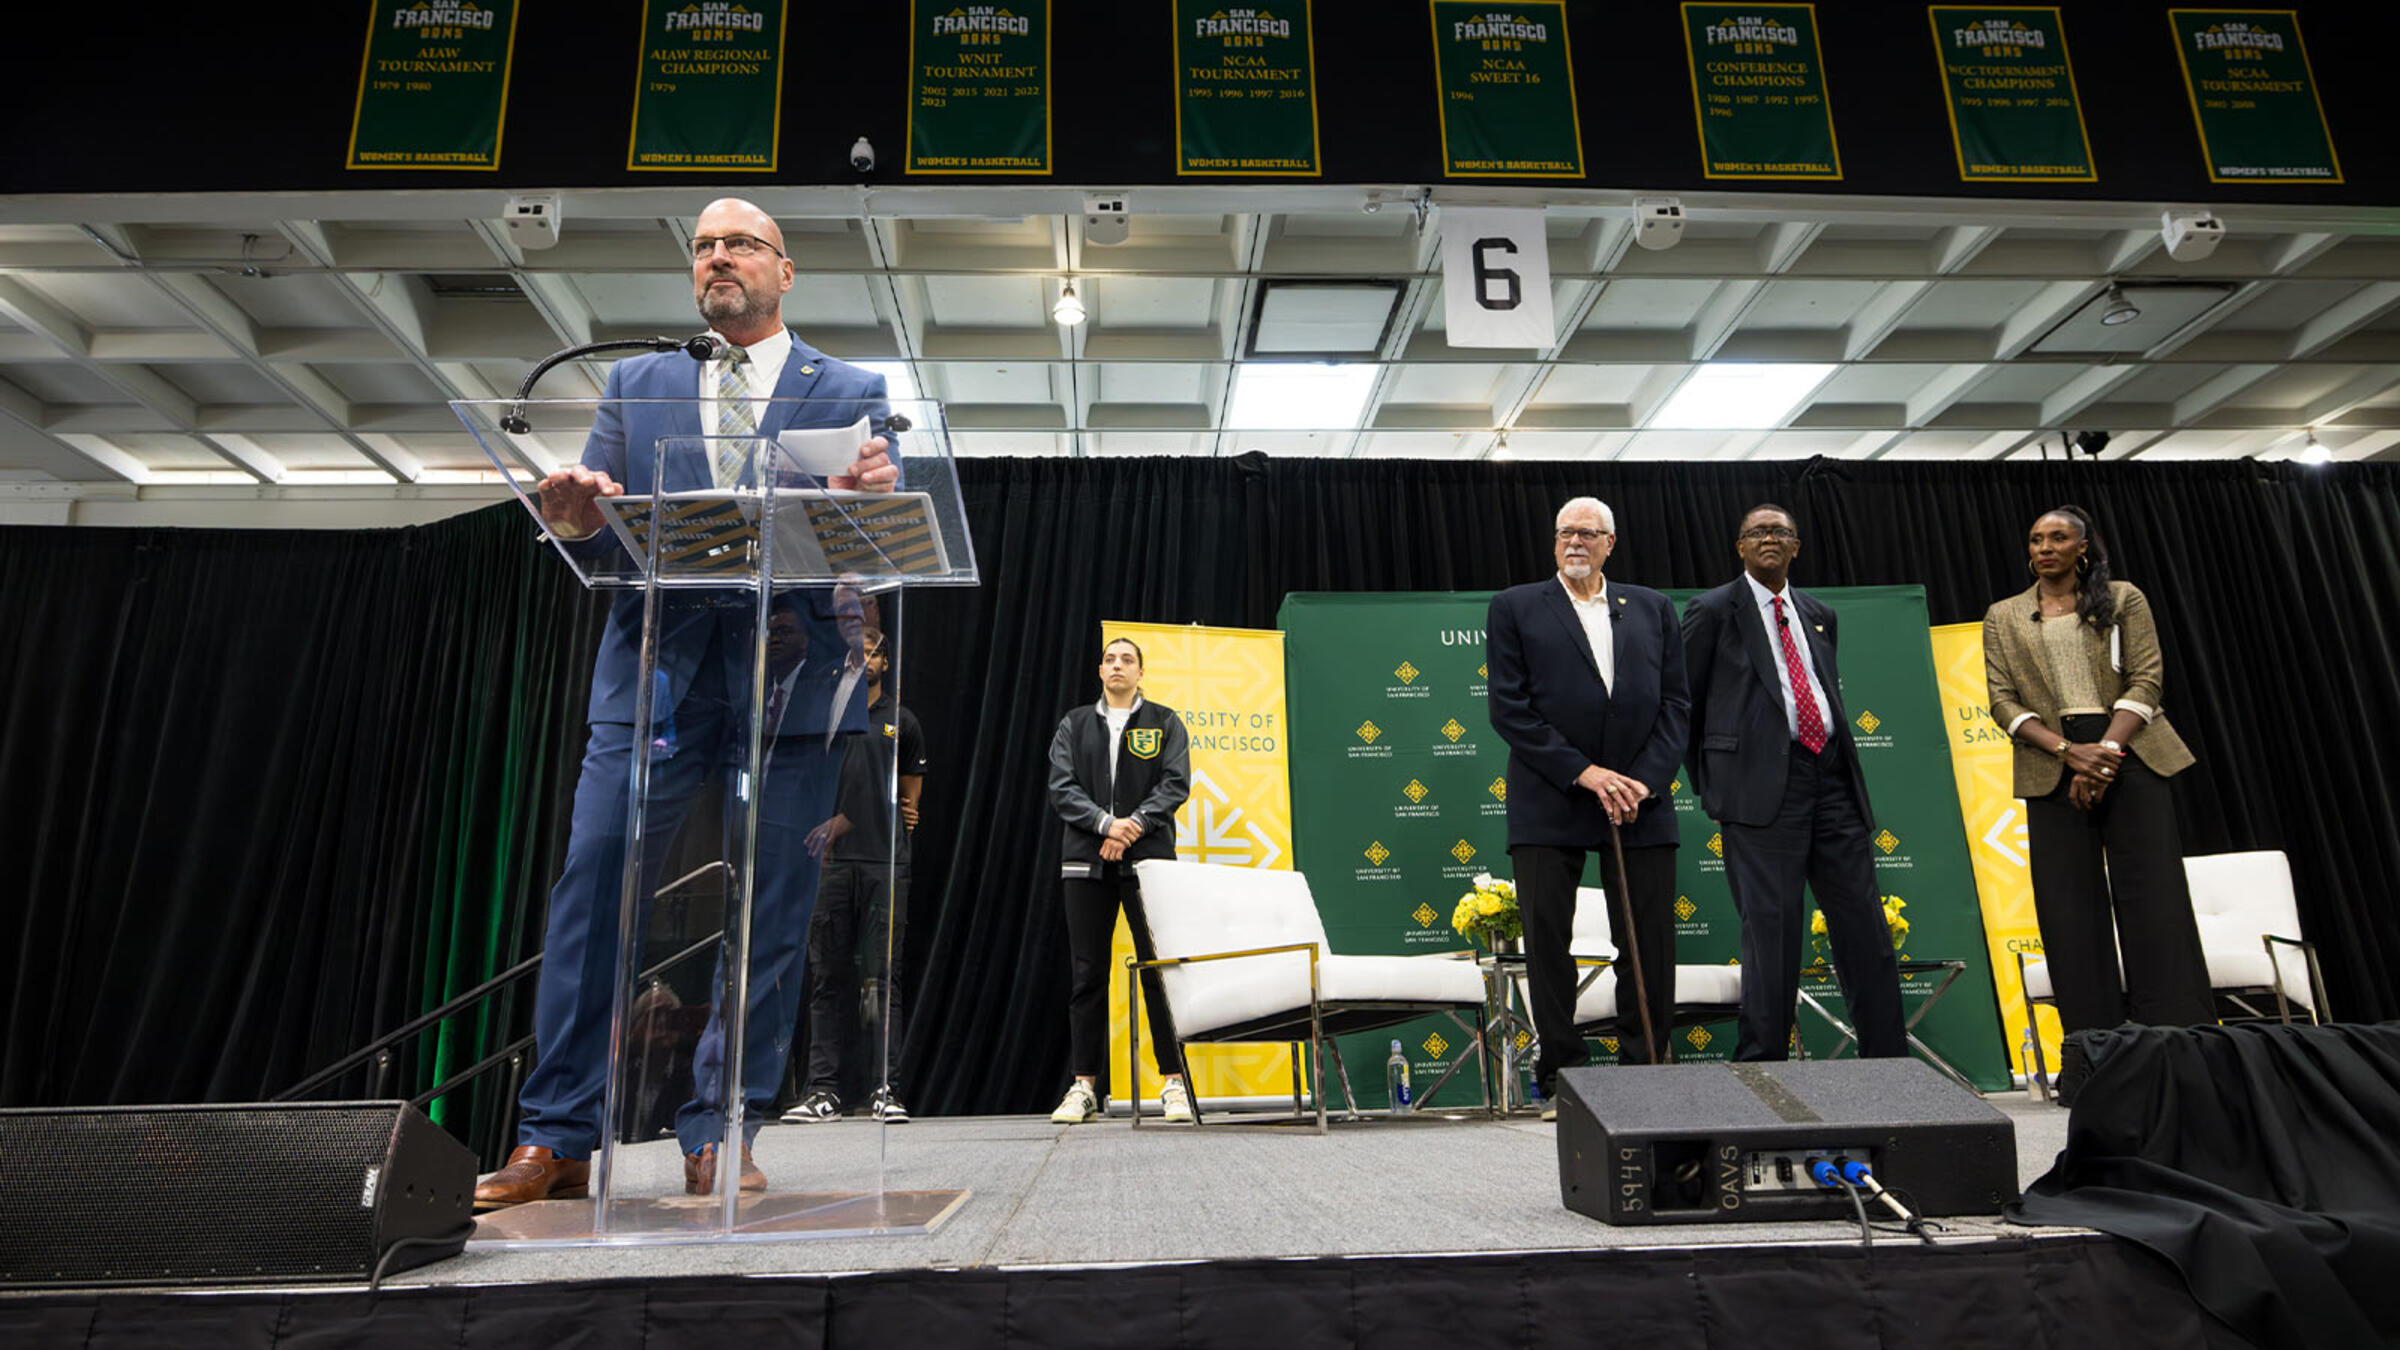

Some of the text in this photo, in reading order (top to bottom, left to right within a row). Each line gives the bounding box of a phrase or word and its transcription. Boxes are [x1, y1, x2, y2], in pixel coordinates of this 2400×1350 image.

[432, 0, 460, 8] SAN
[703, 2, 728, 11] SAN
[968, 6, 994, 15] SAN
[1229, 9, 1255, 18] SAN
[393, 9, 494, 29] FRANCISCO
[665, 12, 763, 32] FRANCISCO
[1486, 13, 1511, 22] SAN
[1737, 16, 1762, 25] SAN
[933, 16, 1029, 36] FRANCISCO
[1196, 18, 1290, 38] FRANCISCO
[1984, 20, 2009, 28] SAN
[2223, 23, 2248, 31] SAN
[420, 28, 463, 38] DONS
[692, 30, 734, 41] DONS
[1454, 22, 1547, 43] FRANCISCO
[1706, 26, 1798, 46] FRANCISCO
[961, 34, 1001, 45] DONS
[1224, 36, 1264, 47] DONS
[1954, 29, 2045, 48] FRANCISCO
[2194, 32, 2284, 51] FRANCISCO
[1482, 40, 1522, 51] DONS
[1734, 43, 1774, 54] DONS
[417, 48, 460, 58] AIAW
[651, 49, 771, 60] AIAW REGIONAL
[1983, 46, 2022, 57] DONS
[2224, 49, 2262, 60] DONS
[958, 53, 1002, 64] WNIT
[1223, 56, 1266, 66] NCAA
[378, 60, 496, 72] TOURNAMENT
[661, 62, 760, 74] CHAMPIONS
[1483, 59, 1526, 70] NCAA
[1706, 61, 1808, 73] CONFERENCE
[924, 65, 1037, 78] TOURNAMENT
[1189, 67, 1301, 80] TOURNAMENT
[1979, 65, 2065, 76] TOURNAMENT
[2227, 68, 2269, 79] NCAA
[1470, 72, 1540, 83] SWEET 16
[1713, 75, 1806, 87] CHAMPIONS
[373, 80, 432, 91] 1979 1980
[650, 82, 676, 93] 1979
[1963, 78, 2056, 90] CHAMPIONS
[2201, 80, 2304, 92] TOURNAMENT
[922, 86, 1039, 96] 2002 2015 2021 2022
[1188, 88, 1305, 99] 1995 1996 1997 2016
[1450, 91, 1474, 101] 1996
[921, 97, 946, 107] 2023
[360, 152, 488, 162] WOMEN'S BASKETBALL
[640, 154, 766, 163] WOMEN'S BASKETBALL
[917, 157, 1040, 166] WOMEN'S BASKETBALL
[1188, 158, 1310, 168] WOMEN'S BASKETBALL
[1455, 160, 1574, 170] WOMEN'S BASKETBALL
[1714, 162, 1831, 172] WOMEN'S BASKETBALL
[1971, 164, 2086, 174] WOMEN'S BASKETBALL
[2220, 167, 2331, 176] WOMEN'S VOLLEYBALL
[1472, 237, 1522, 311] 6
[1250, 713, 1273, 728] OF
[1621, 1147, 1643, 1212] 5949
[1720, 1145, 1739, 1210] OAVS
